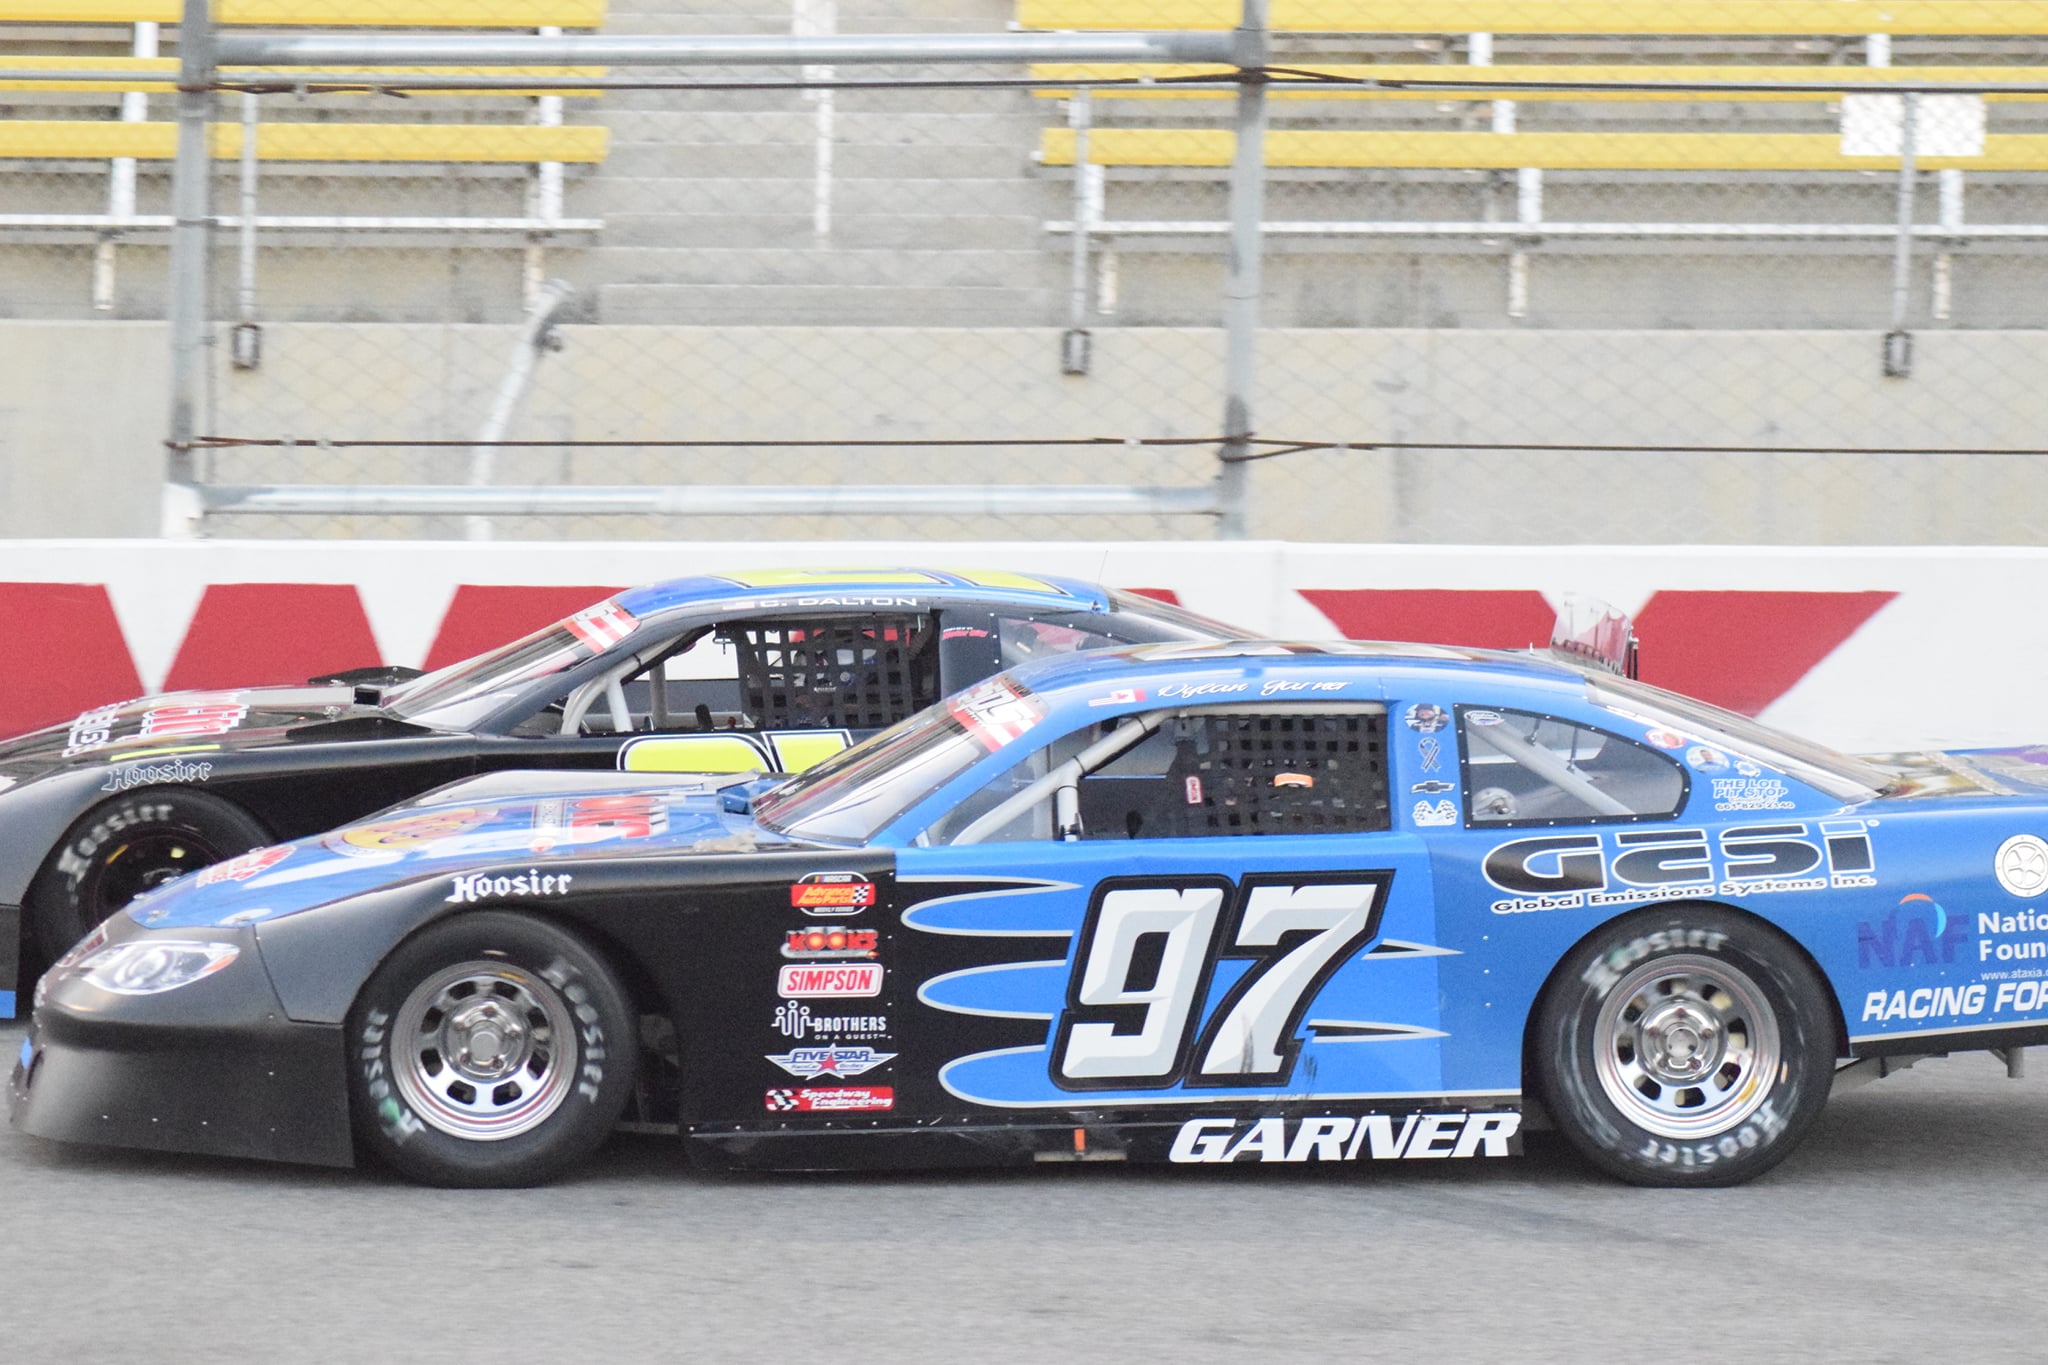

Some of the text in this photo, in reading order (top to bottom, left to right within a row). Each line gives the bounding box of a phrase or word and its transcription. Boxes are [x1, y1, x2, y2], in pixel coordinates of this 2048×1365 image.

[797, 597, 918, 606] DALTON
[101, 758, 213, 792] Hoosier
[1712, 779, 1746, 789] THE
[1714, 787, 1789, 798] PIT STOP
[444, 868, 573, 903] Hoosier
[804, 886, 852, 897] Advance
[1492, 875, 1876, 912] Global Emissions Systems Inc.
[1856, 911, 1970, 969] NAF
[1979, 938, 2048, 962] Foun
[787, 970, 873, 991] SIMPSON
[1054, 874, 1389, 1087] 97
[1861, 983, 1988, 1022] RACING
[814, 1016, 887, 1033] BROTHERS
[814, 1033, 829, 1041] ON
[792, 1050, 870, 1063] FIVE STAR
[800, 1088, 871, 1101] Speedway
[811, 1096, 893, 1110] Engineering
[1169, 1111, 1522, 1164] GARNER
